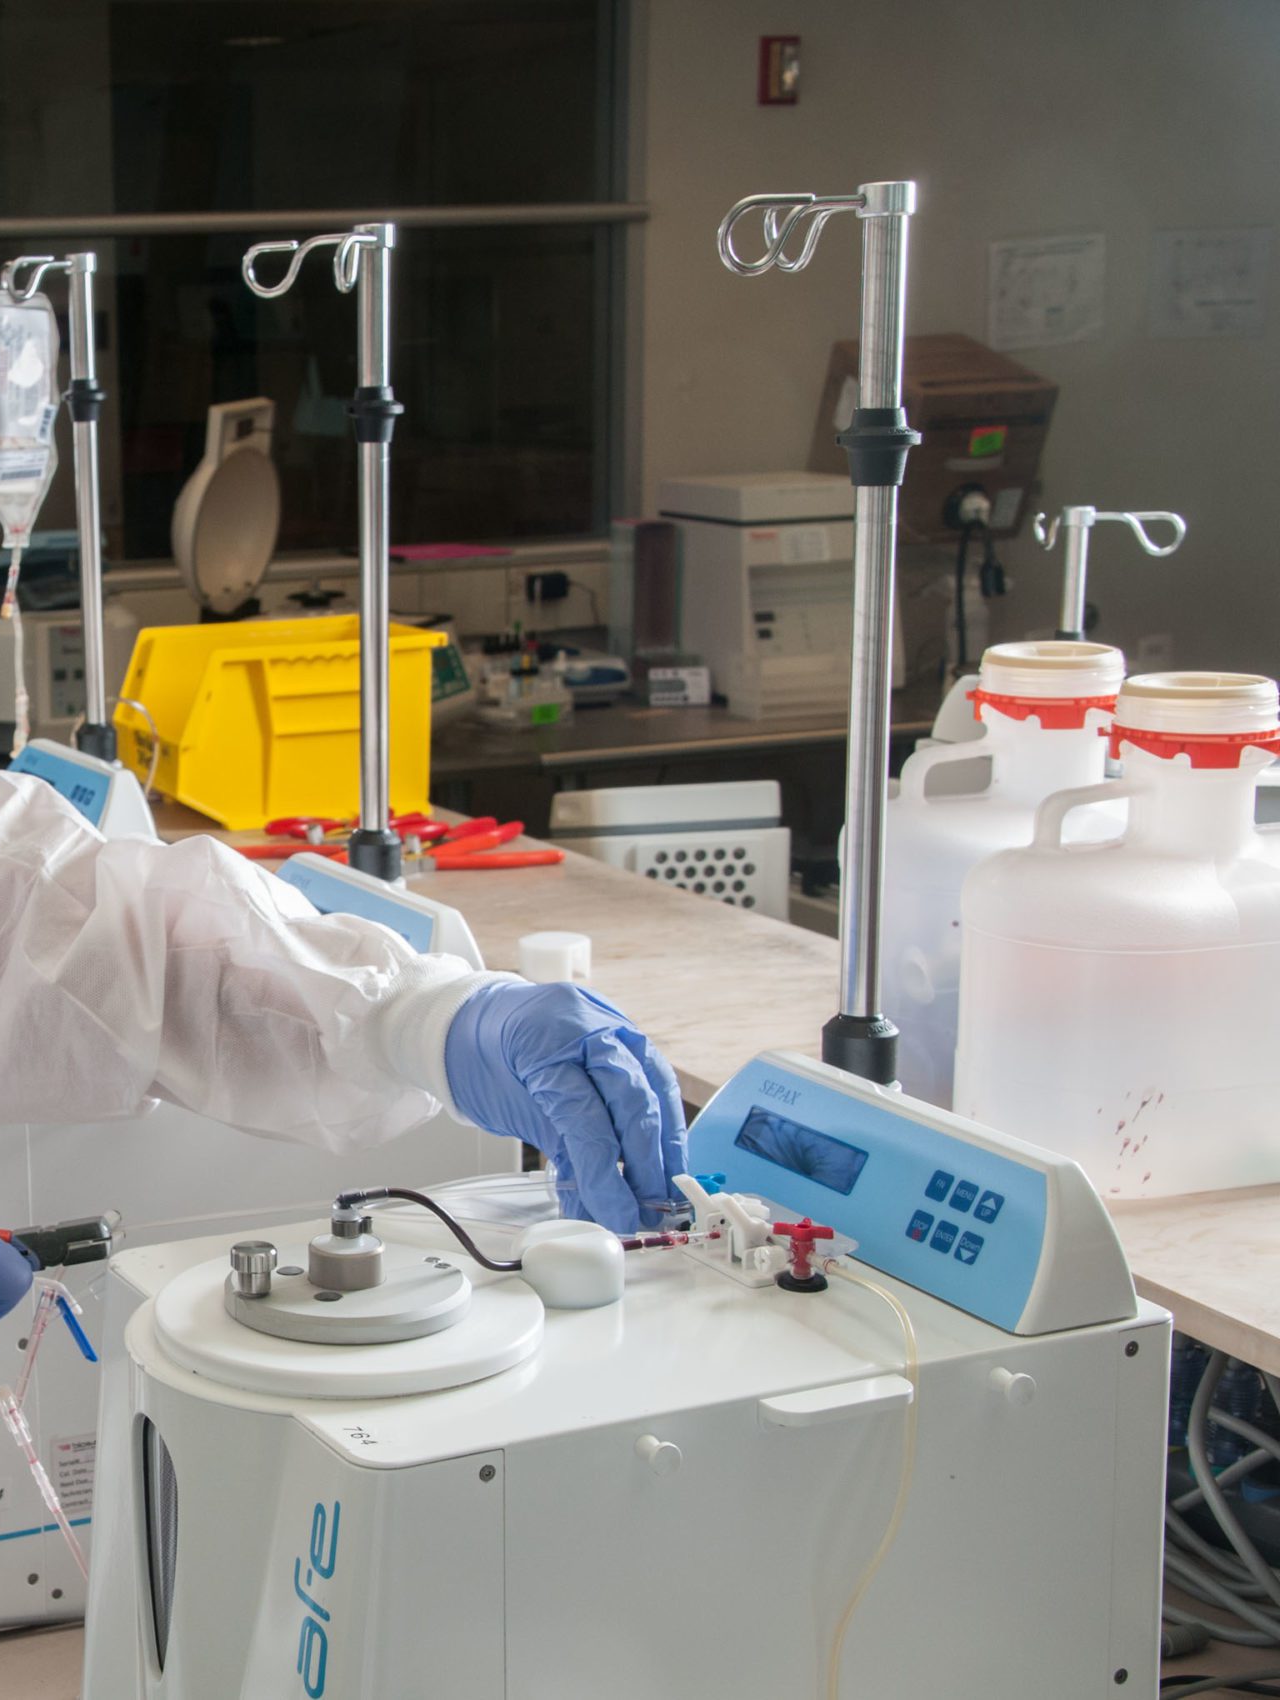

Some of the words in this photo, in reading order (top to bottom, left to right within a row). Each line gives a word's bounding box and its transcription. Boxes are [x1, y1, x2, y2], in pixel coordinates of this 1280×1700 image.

[758, 1080, 802, 1106] SEPAX
[955, 1187, 975, 1200] MENU
[980, 1207, 992, 1218] UP
[935, 1229, 954, 1242] ENTER
